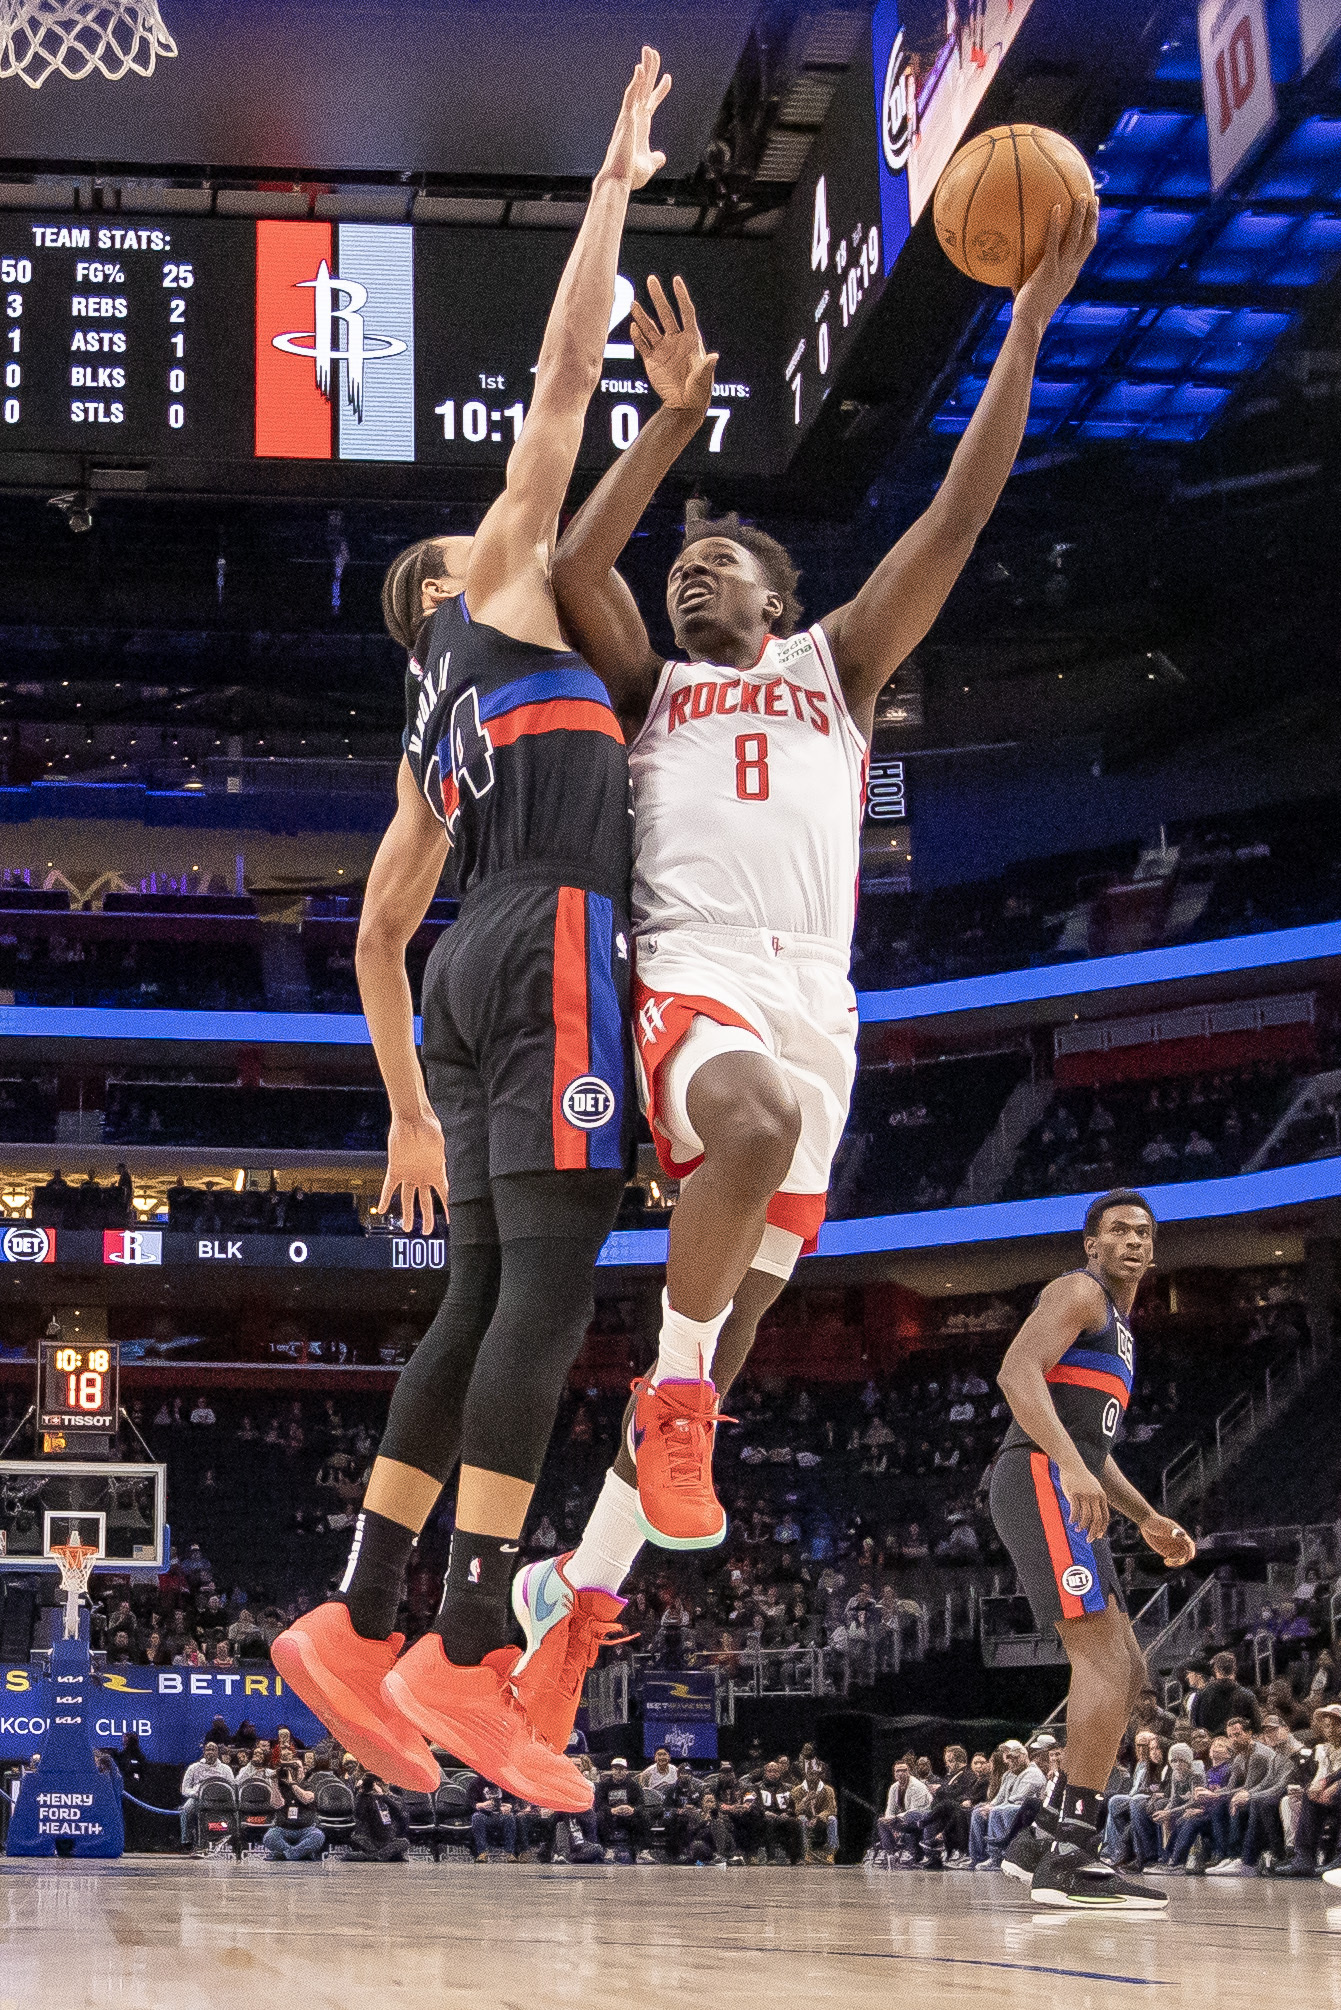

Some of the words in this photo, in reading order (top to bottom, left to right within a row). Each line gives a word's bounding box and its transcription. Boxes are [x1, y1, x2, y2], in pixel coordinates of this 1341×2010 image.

[31, 227, 91, 248] TEAM
[98, 229, 172, 251] STATS:
[1, 259, 32, 284] 50
[76, 262, 125, 283] FG%
[162, 264, 195, 289] 25
[6, 294, 23, 318] 3
[71, 296, 128, 318] REBS
[169, 299, 186, 323] 2
[7, 328, 21, 353] 1
[71, 331, 127, 353] ASTS
[171, 333, 184, 358] 1
[5, 363, 21, 388] 0
[71, 366, 126, 388] BLKS
[169, 369, 185, 393] 0
[478, 373, 505, 390] 1st
[600, 379, 649, 394] FOULS:
[4, 399, 20, 424] 0
[71, 401, 124, 424] STLS
[168, 404, 184, 429] 0
[610, 403, 640, 451] 0
[705, 407, 731, 453] 7
[667, 676, 831, 738] ROCKETS
[735, 732, 769, 802] 8
[868, 761, 906, 819] HOU
[572, 1093, 606, 1112] DET
[11, 1237, 42, 1253] DET
[198, 1240, 243, 1259] BLK
[288, 1241, 308, 1263] 0
[392, 1238, 446, 1269] HOU
[55, 1348, 110, 1372] 10:18
[69, 1371, 104, 1409] 18
[61, 1415, 113, 1427] TISSOT
[1102, 1398, 1120, 1438] 0
[5, 1670, 32, 1692] S
[158, 1673, 283, 1696] BETRI
[0, 1717, 50, 1735] KCO
[95, 1718, 152, 1736] CLUB
[36, 1792, 93, 1806] HENRY
[39, 1807, 81, 1820] FORD
[38, 1821, 103, 1835] HEALTH
